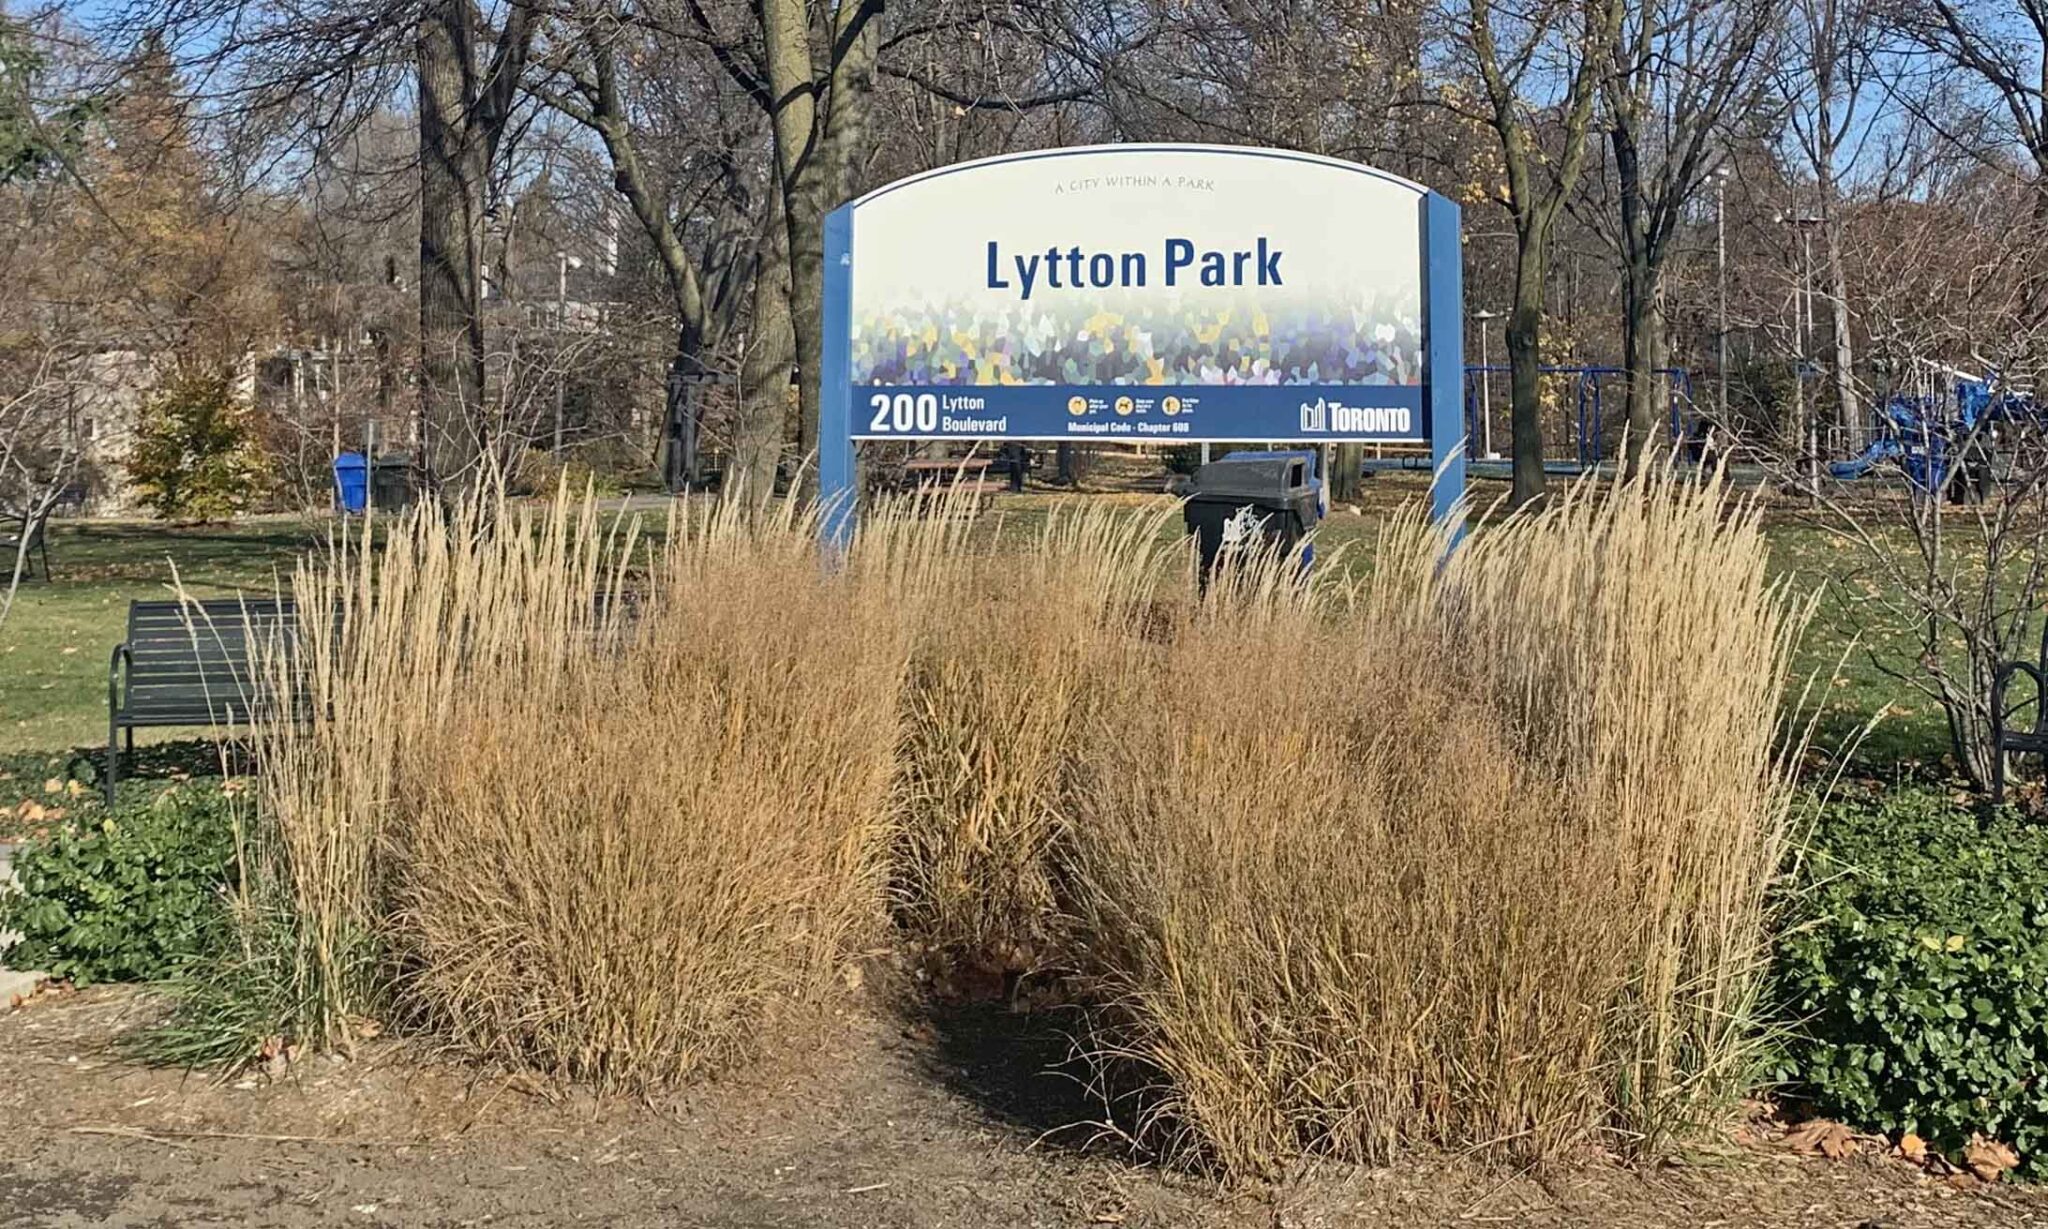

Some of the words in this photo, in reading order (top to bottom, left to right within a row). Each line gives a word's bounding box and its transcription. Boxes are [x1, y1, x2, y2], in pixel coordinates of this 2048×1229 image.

[1055, 182, 1064, 194] A
[1070, 178, 1099, 191] CITY
[1106, 175, 1157, 187] WITHIN
[1162, 175, 1172, 187] A
[1178, 176, 1214, 191] PARK
[986, 241, 1147, 300] Lytton
[1165, 237, 1283, 287] Park
[870, 393, 938, 432] 200
[942, 394, 985, 413] Lytton
[942, 416, 1007, 432] Boulevard
[1328, 402, 1411, 432] TORONTO
[1068, 422, 1109, 434] Municipal
[1110, 422, 1131, 433] Code
[1138, 422, 1171, 434] Chapter
